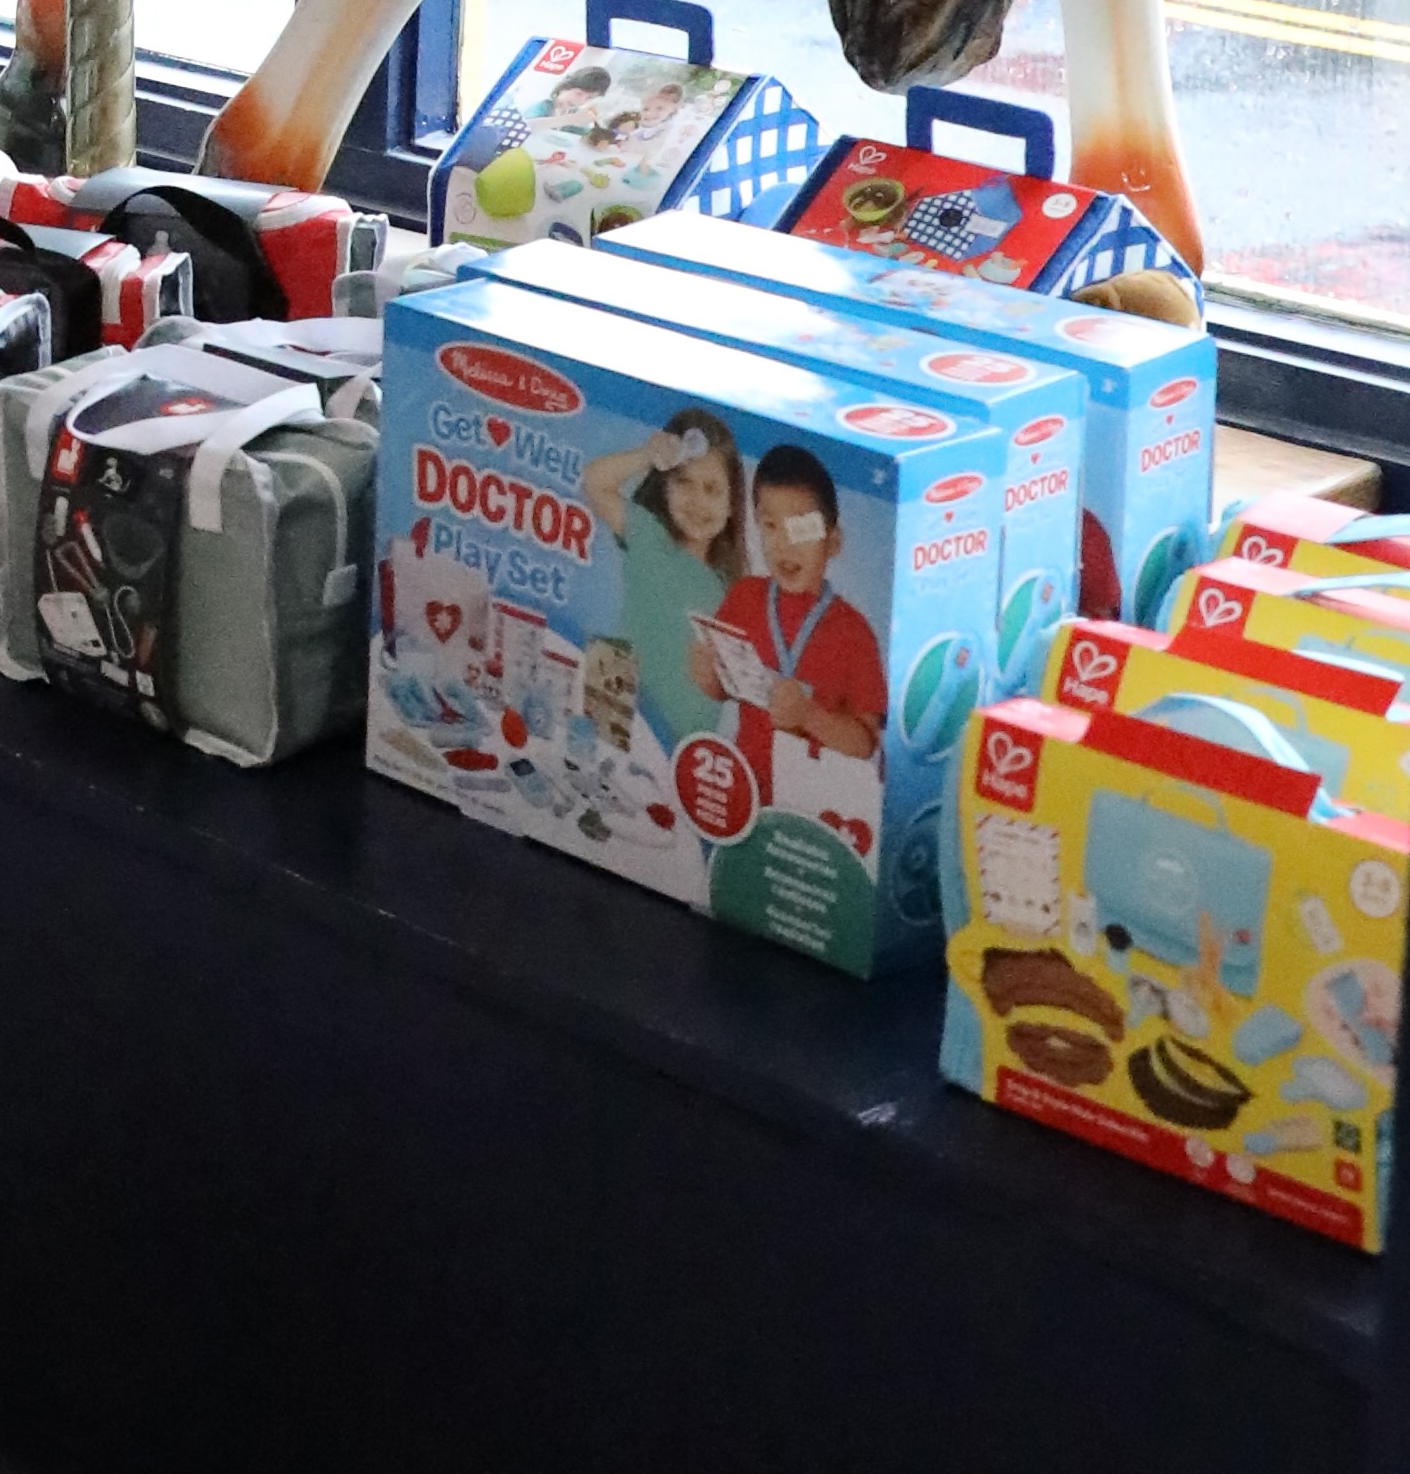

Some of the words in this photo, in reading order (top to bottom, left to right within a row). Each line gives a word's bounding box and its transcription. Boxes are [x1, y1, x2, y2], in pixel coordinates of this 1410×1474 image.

[433, 404, 485, 445] Get
[1141, 430, 1201, 473] DOCTOR
[415, 447, 592, 562] DOCTOR
[1004, 470, 1069, 512] DOCTOR
[433, 521, 503, 585] Play
[509, 551, 567, 601] Set
[914, 529, 988, 571] DOCTOR
[692, 746, 735, 789] 25
